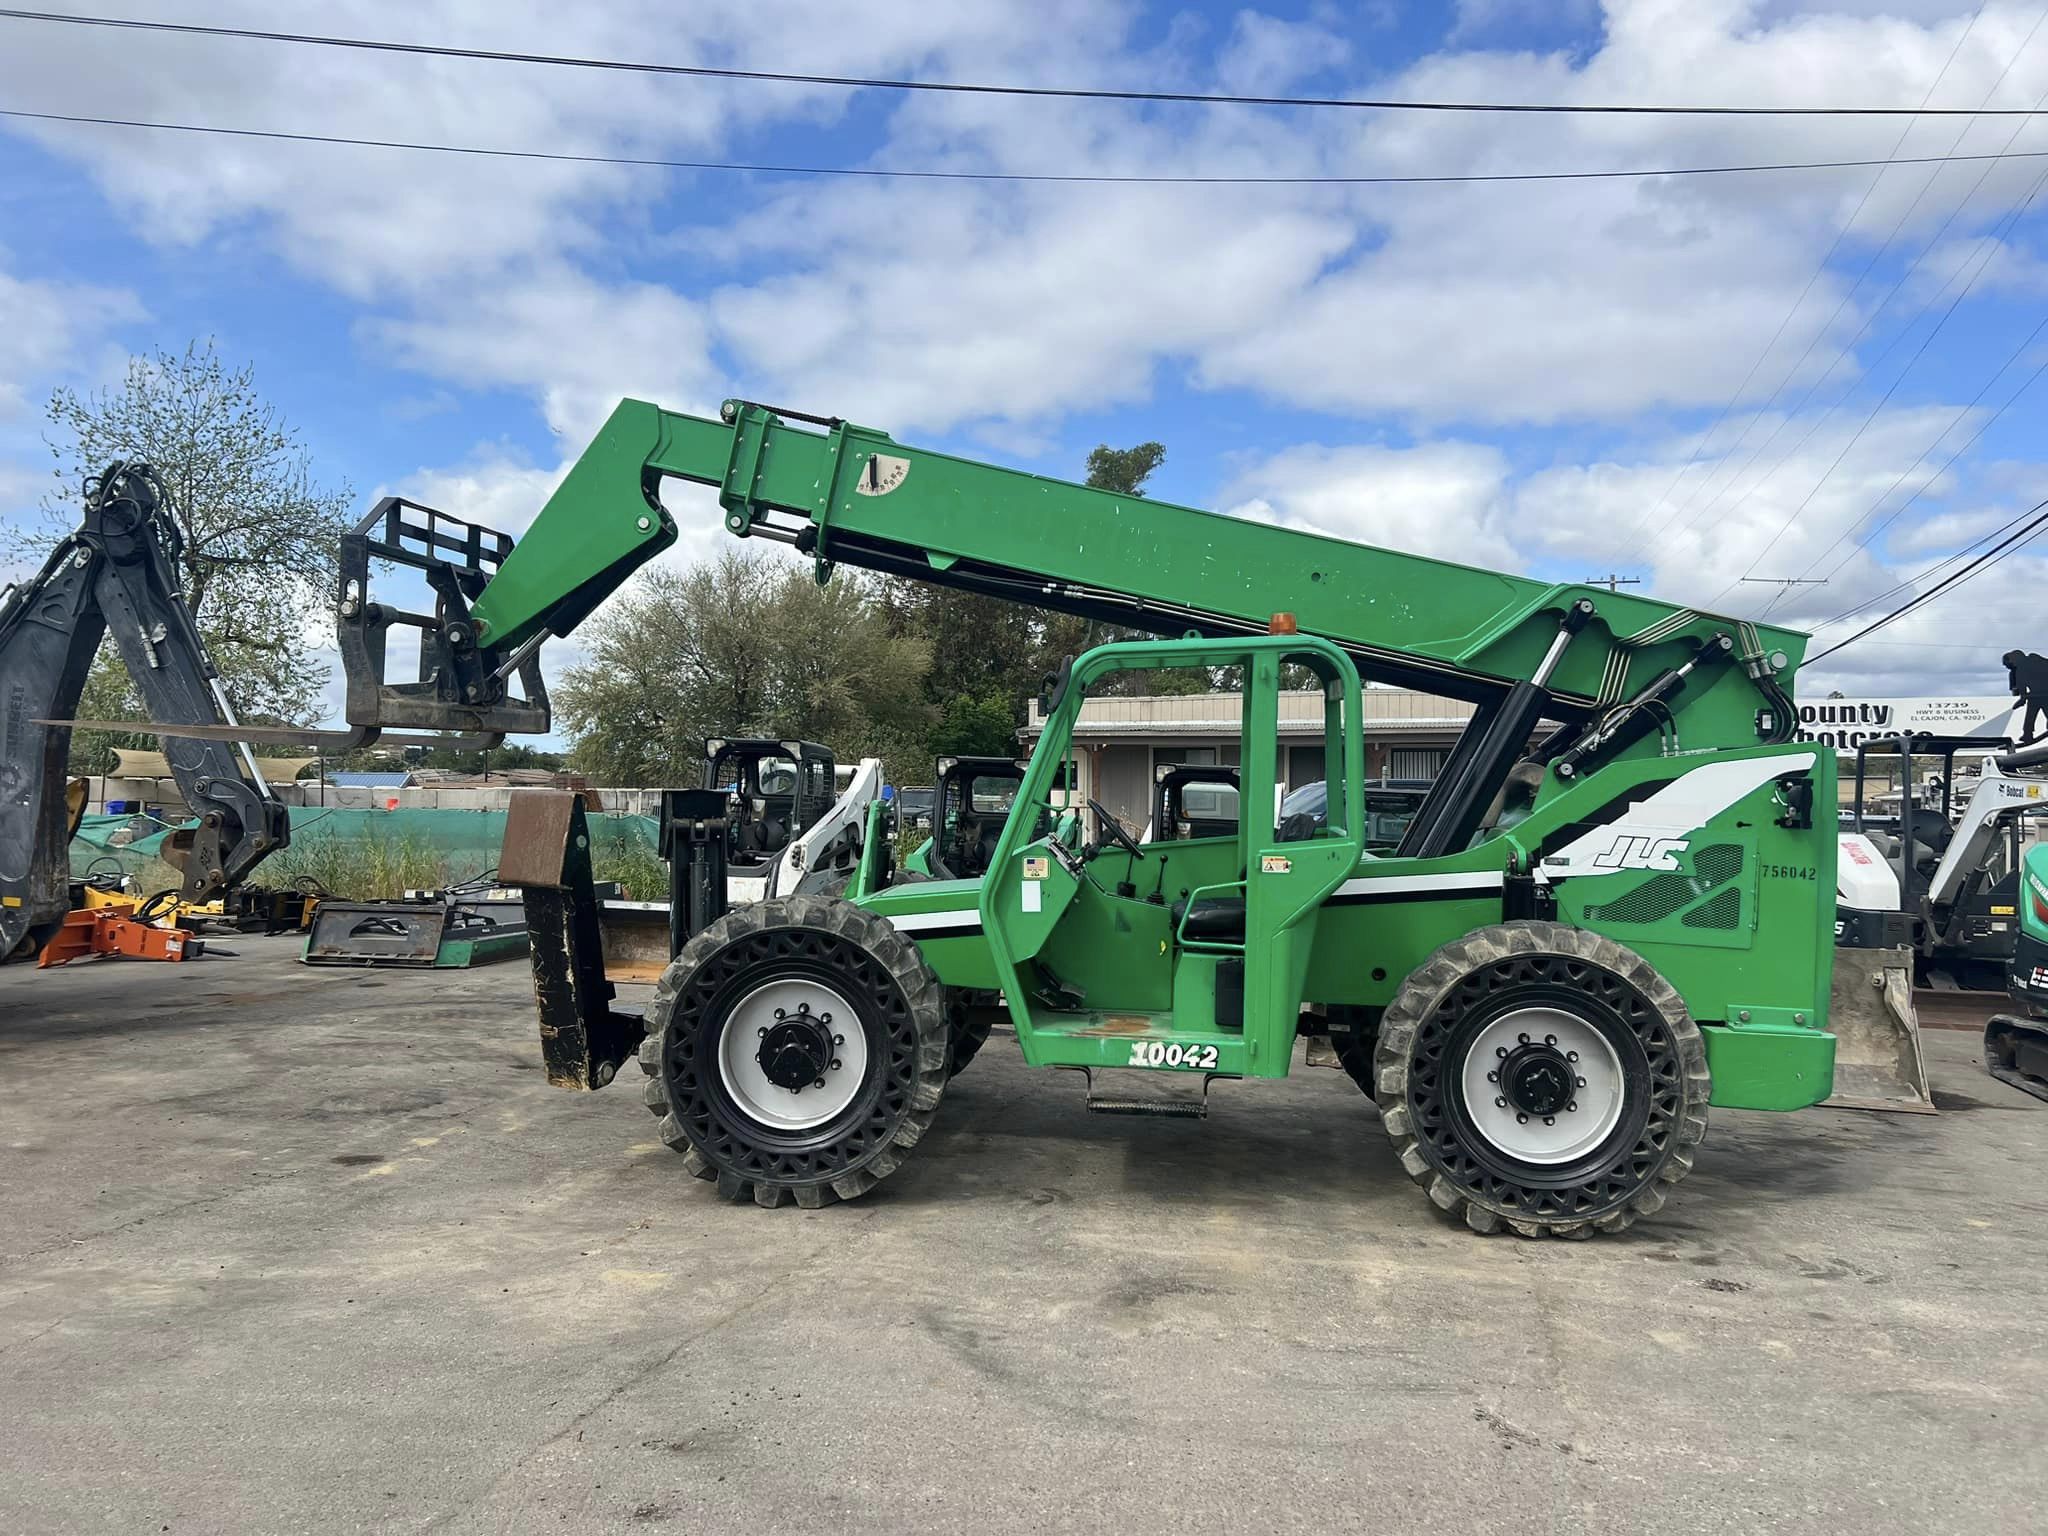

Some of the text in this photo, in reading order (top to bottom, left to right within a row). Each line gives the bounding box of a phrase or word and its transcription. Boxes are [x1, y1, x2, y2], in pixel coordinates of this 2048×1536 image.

[1800, 703, 1889, 725] ounty
[1593, 835, 1691, 871] JLG
[1762, 864, 1817, 881] 756042
[1128, 1041, 1219, 1069] 10042
